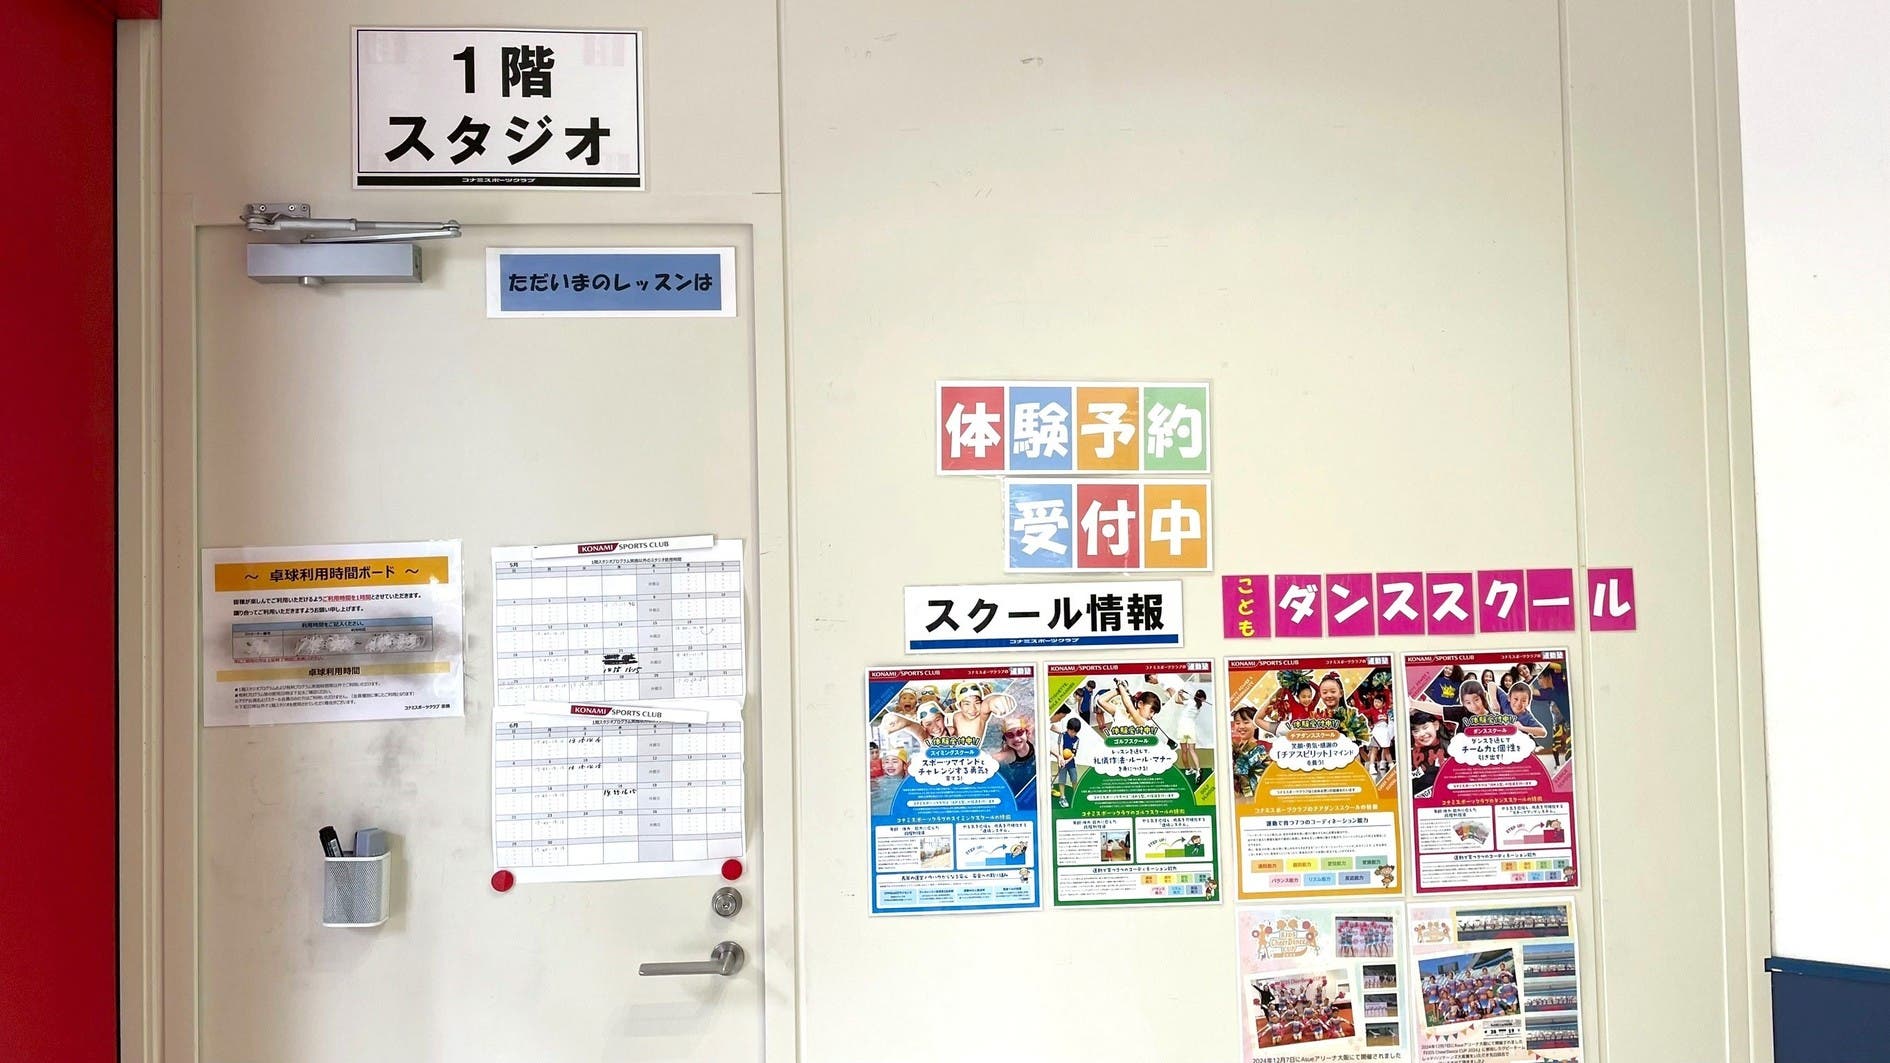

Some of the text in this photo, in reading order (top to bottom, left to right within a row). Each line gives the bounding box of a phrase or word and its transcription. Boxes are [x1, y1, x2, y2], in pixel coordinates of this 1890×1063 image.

[452, 44, 555, 98] 1階
[384, 115, 611, 165] スタジオ
[508, 272, 714, 292] ただいまのレッスンは
[945, 401, 1204, 459] 体験予約
[1013, 499, 1202, 557] 受付中
[582, 541, 669, 553] KONAMI SPORTS CLUB
[270, 564, 396, 583] 卓球利用時間ボード
[1237, 577, 1255, 637] こども
[1279, 577, 1632, 626] ダンススクール
[925, 593, 1165, 634] スクール情報
[309, 666, 360, 677] 卓球利用時間
[575, 706, 662, 718] KONAMI SPORTS CLUB
[1277, 749, 1354, 759] 「チアスピリット」マインド
[1461, 743, 1521, 753] チーム力と個性を
[918, 766, 989, 776] チャレンジする勇気を
[922, 758, 985, 767] スポーツマインドと
